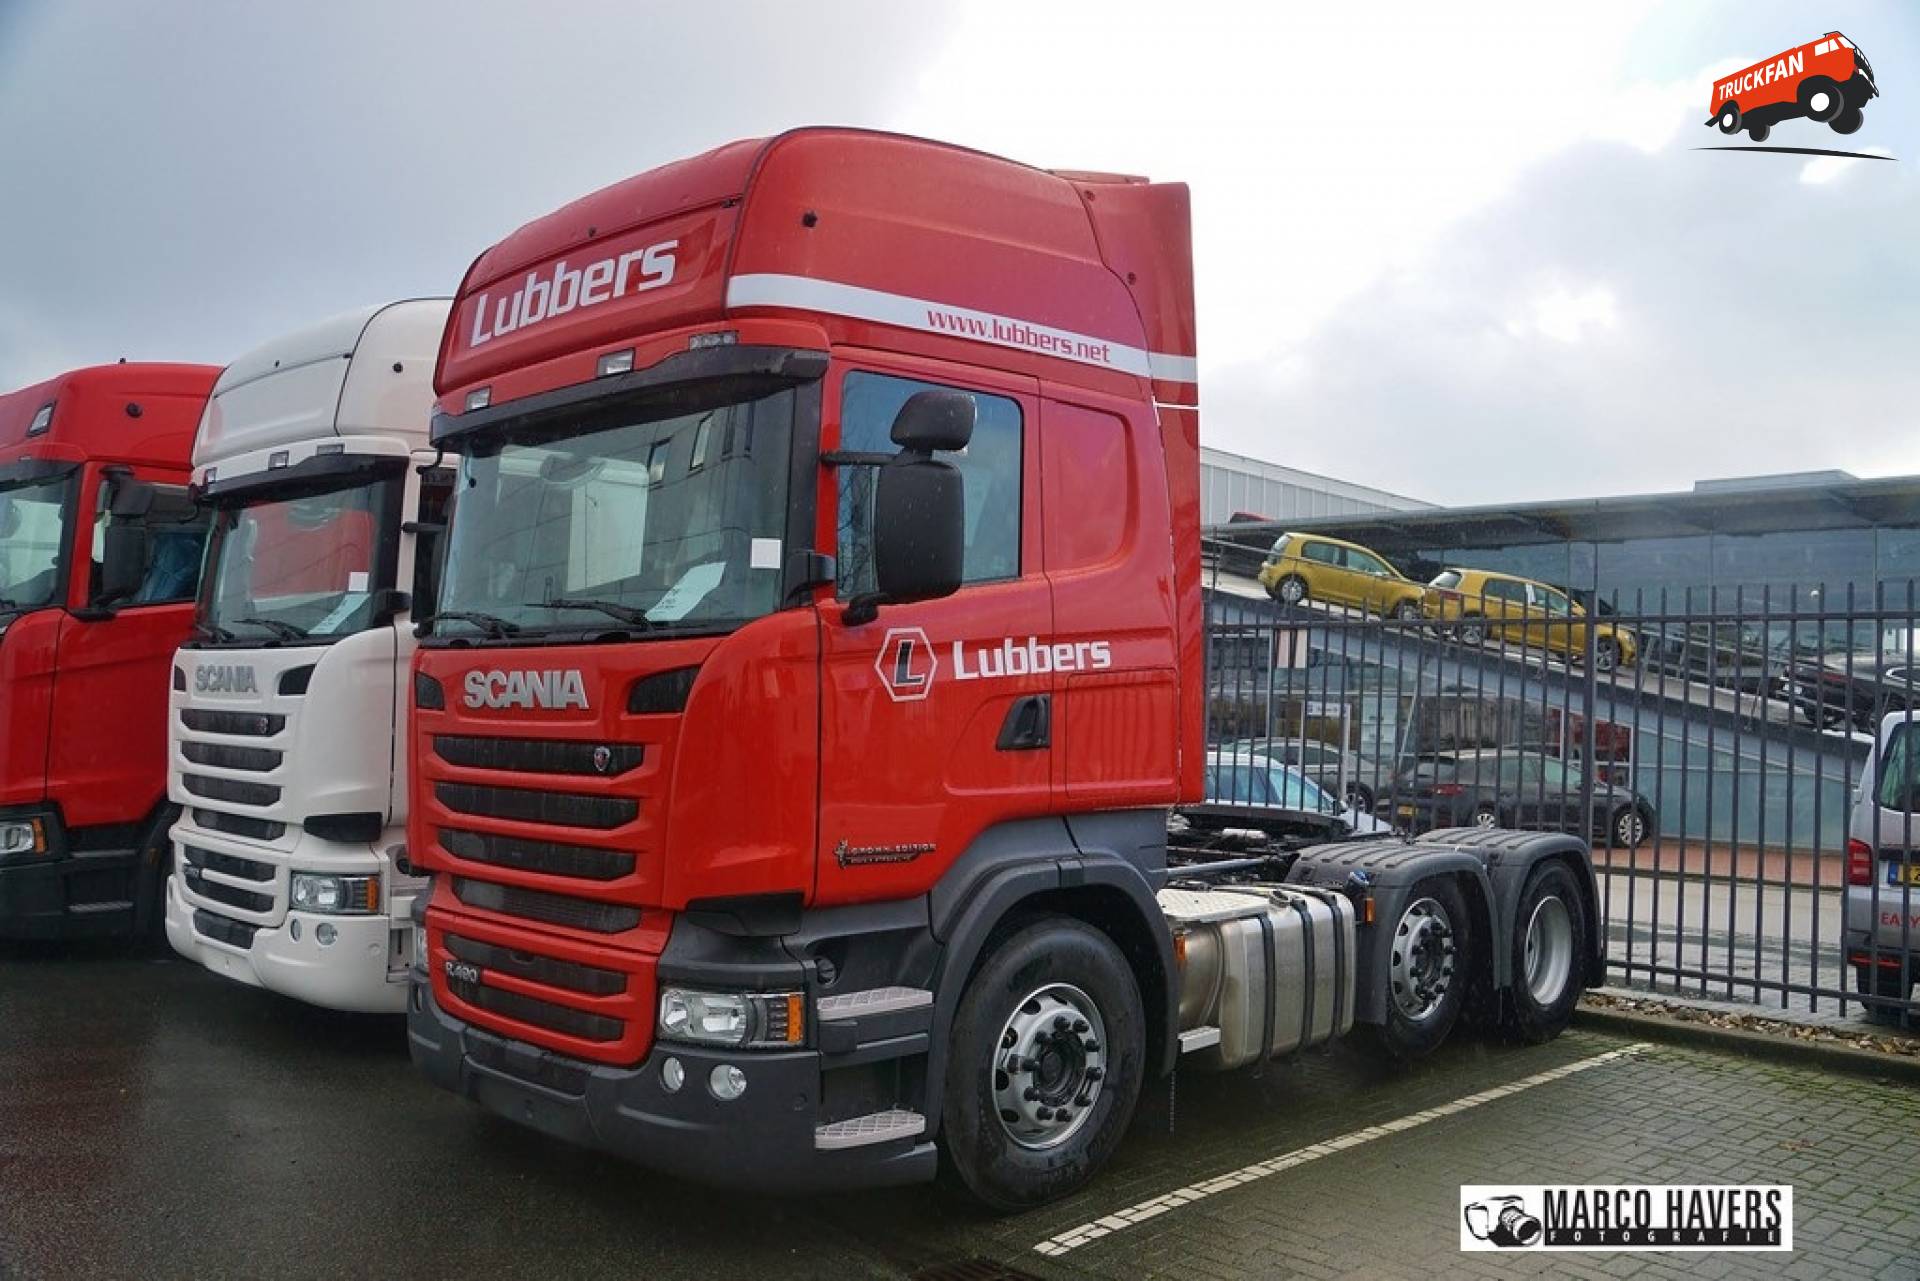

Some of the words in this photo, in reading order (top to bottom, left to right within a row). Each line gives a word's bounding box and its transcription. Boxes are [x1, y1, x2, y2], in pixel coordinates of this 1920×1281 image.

[470, 240, 678, 347] Lubbers
[927, 310, 1110, 362] www.lubbers.net
[196, 664, 258, 693] SCANIA
[953, 637, 1111, 680] Lubbers
[464, 670, 590, 709] SCANIA
